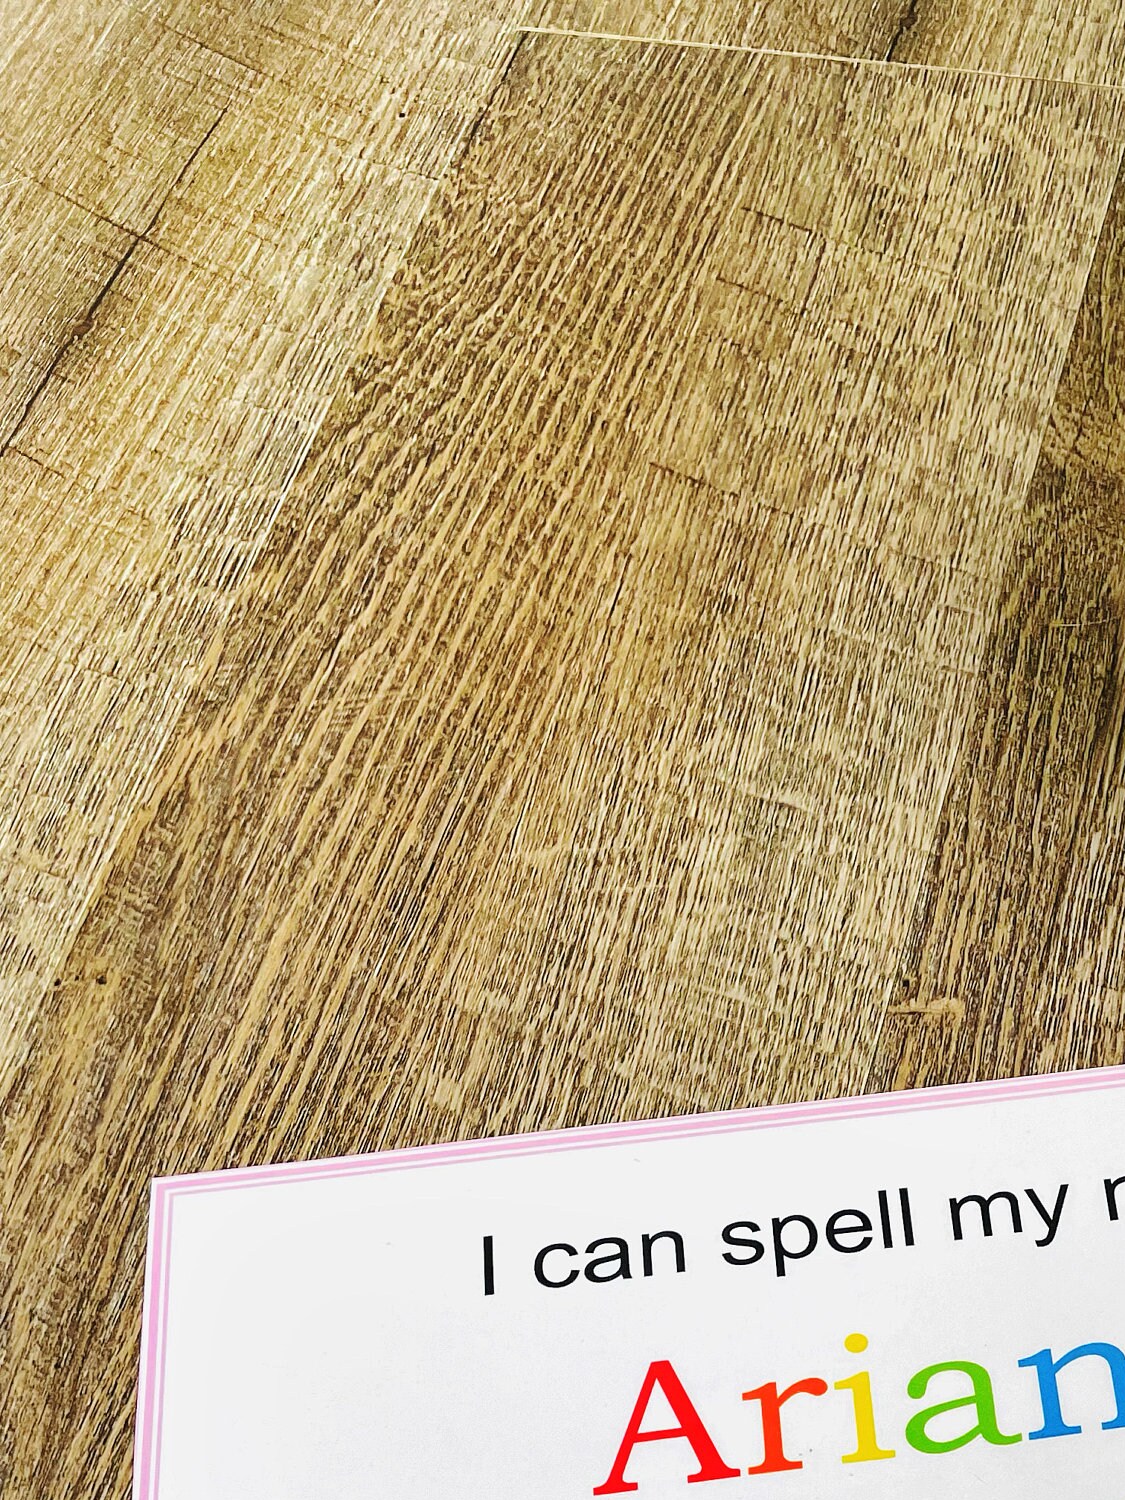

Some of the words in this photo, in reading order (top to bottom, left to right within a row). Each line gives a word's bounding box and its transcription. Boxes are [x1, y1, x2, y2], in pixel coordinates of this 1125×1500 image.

[483, 1235, 495, 1296] I
[533, 1231, 686, 1289] can
[721, 1187, 915, 1278] spell
[948, 1183, 1069, 1248] my
